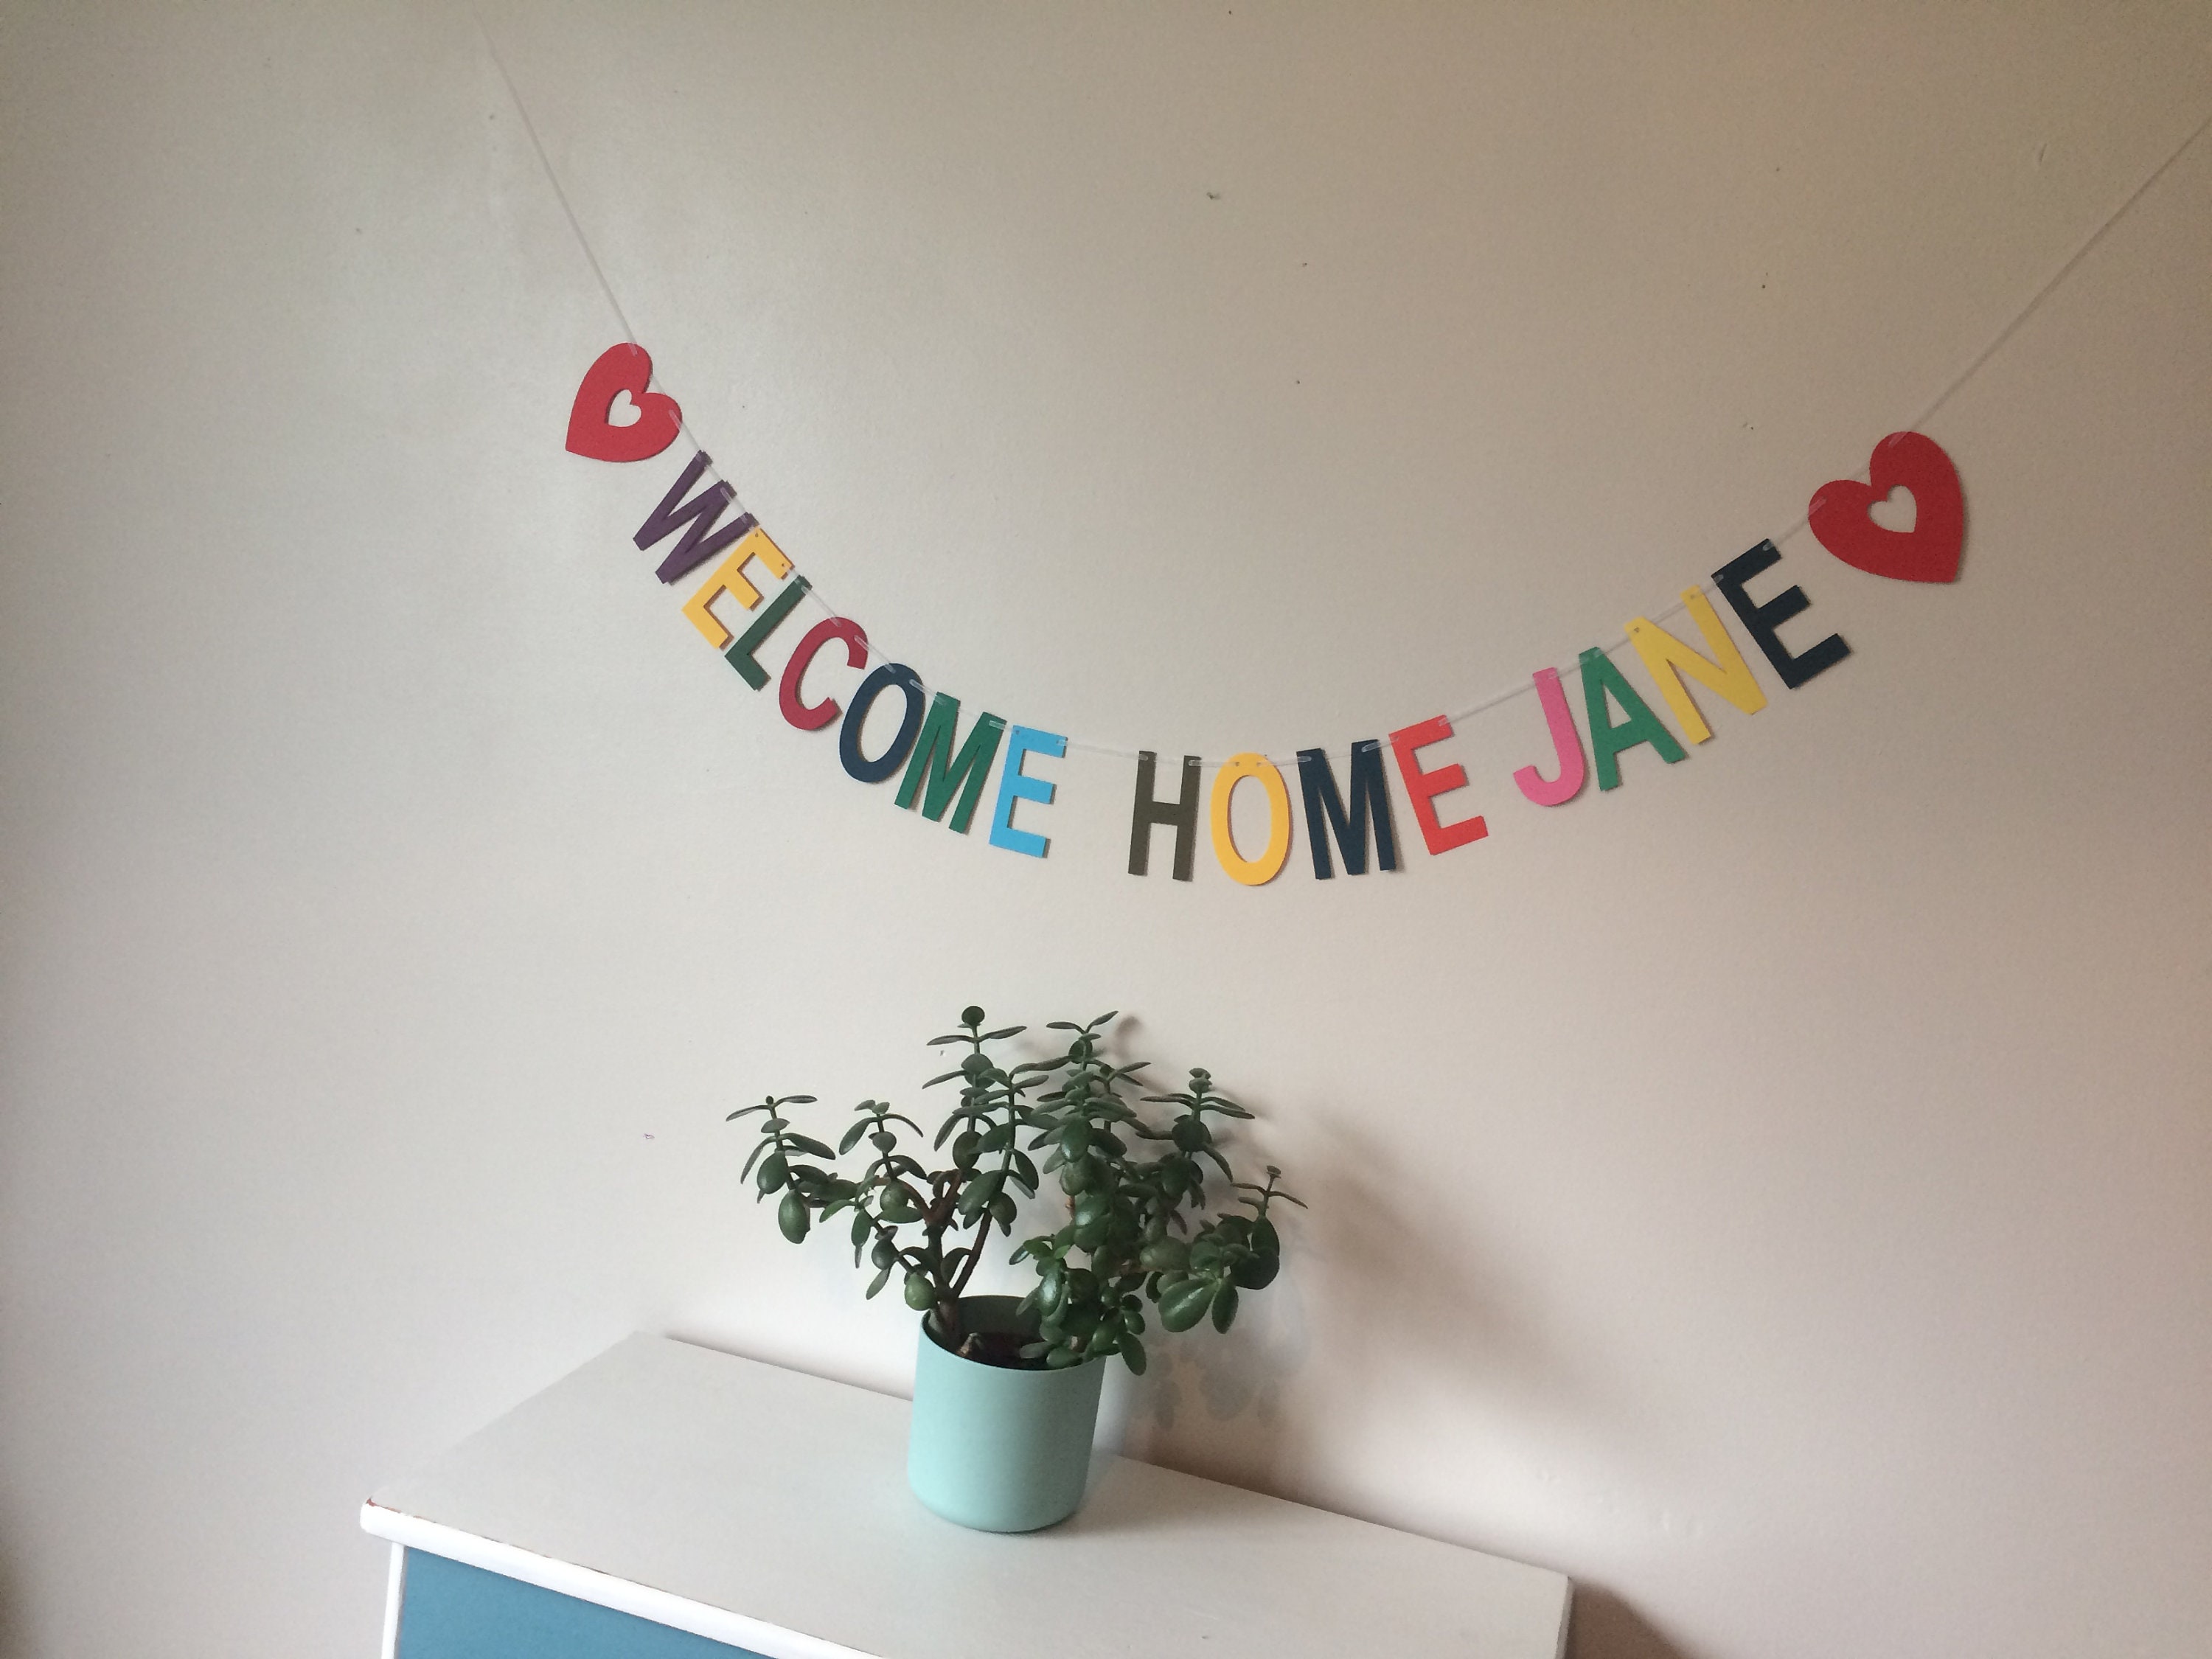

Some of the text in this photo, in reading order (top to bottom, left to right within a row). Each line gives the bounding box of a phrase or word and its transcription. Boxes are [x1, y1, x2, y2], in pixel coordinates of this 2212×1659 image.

[633, 450, 1851, 885] WELCOME HOME JANE
